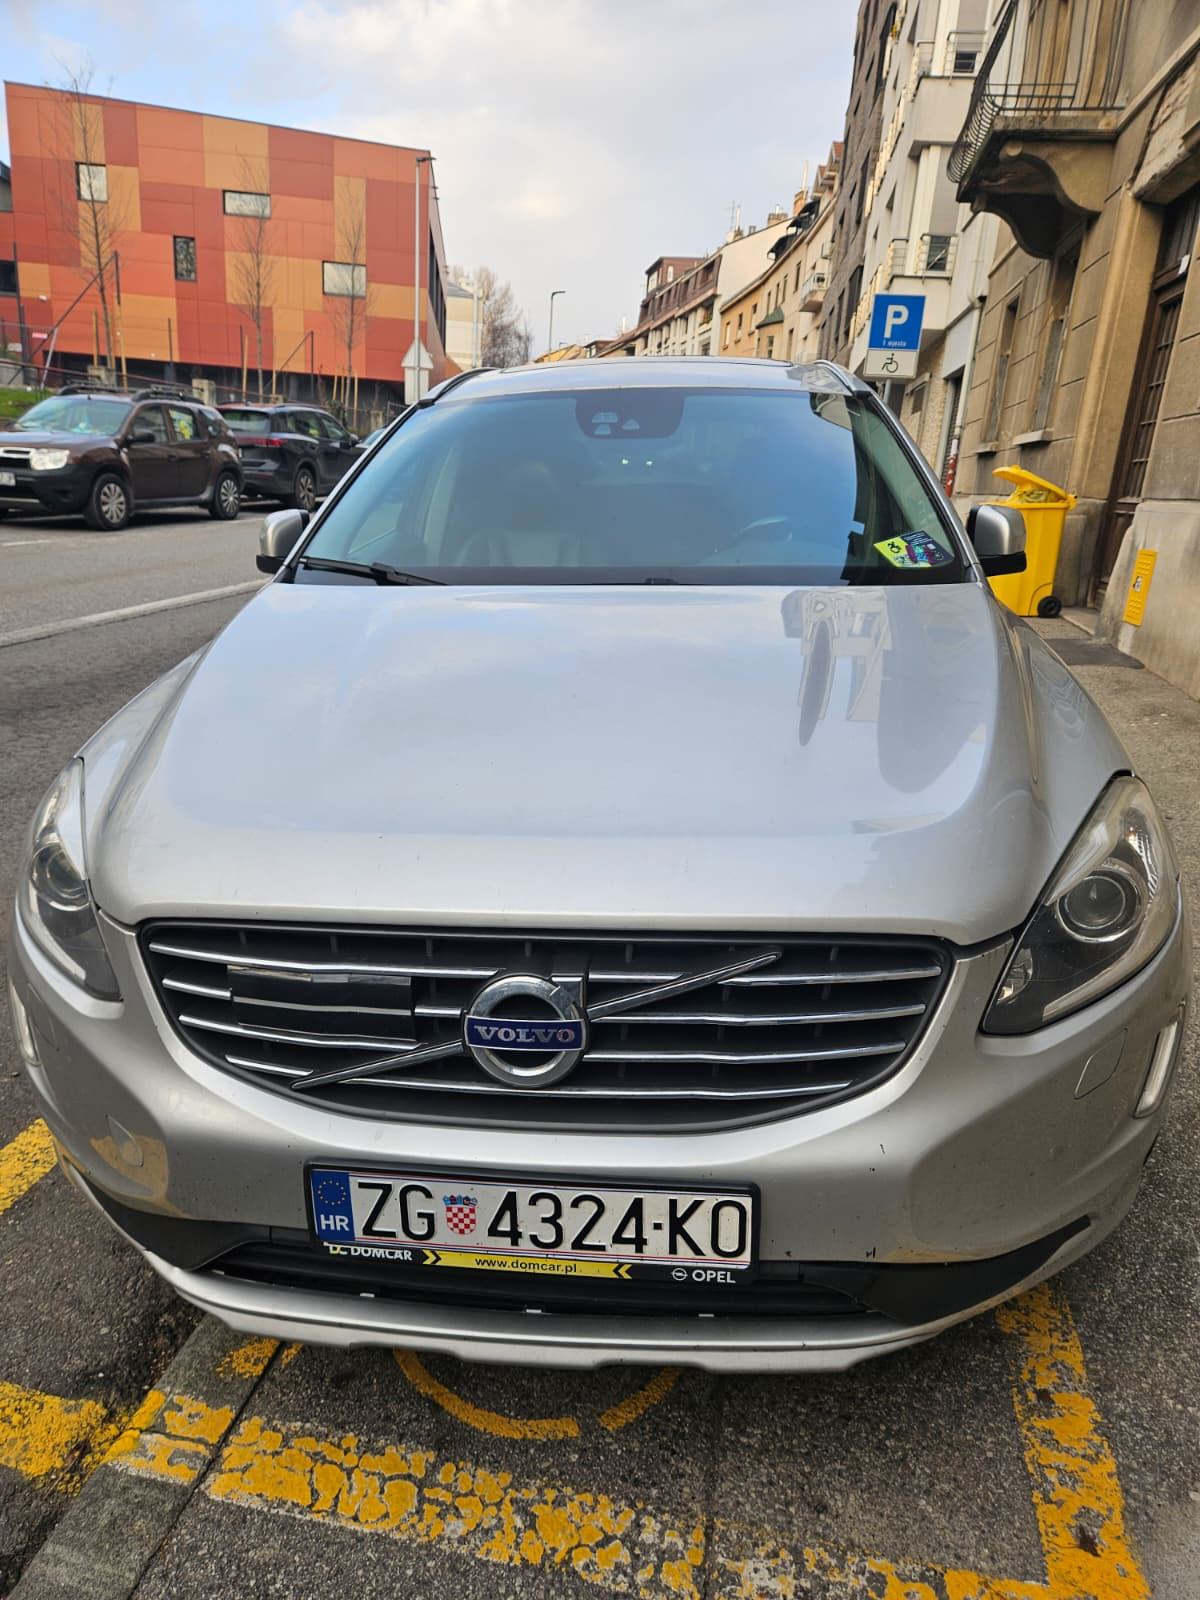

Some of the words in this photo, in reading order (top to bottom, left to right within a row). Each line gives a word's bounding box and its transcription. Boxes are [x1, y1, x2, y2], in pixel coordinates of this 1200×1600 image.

[884, 304, 909, 338] P
[474, 1025, 575, 1043] VOLVO
[358, 1182, 435, 1241] ZG
[320, 1214, 349, 1231] HR
[351, 1248, 412, 1261] DOMCAR
[475, 1257, 577, 1273] www.domcar.pl
[692, 1269, 736, 1284] OPEL
